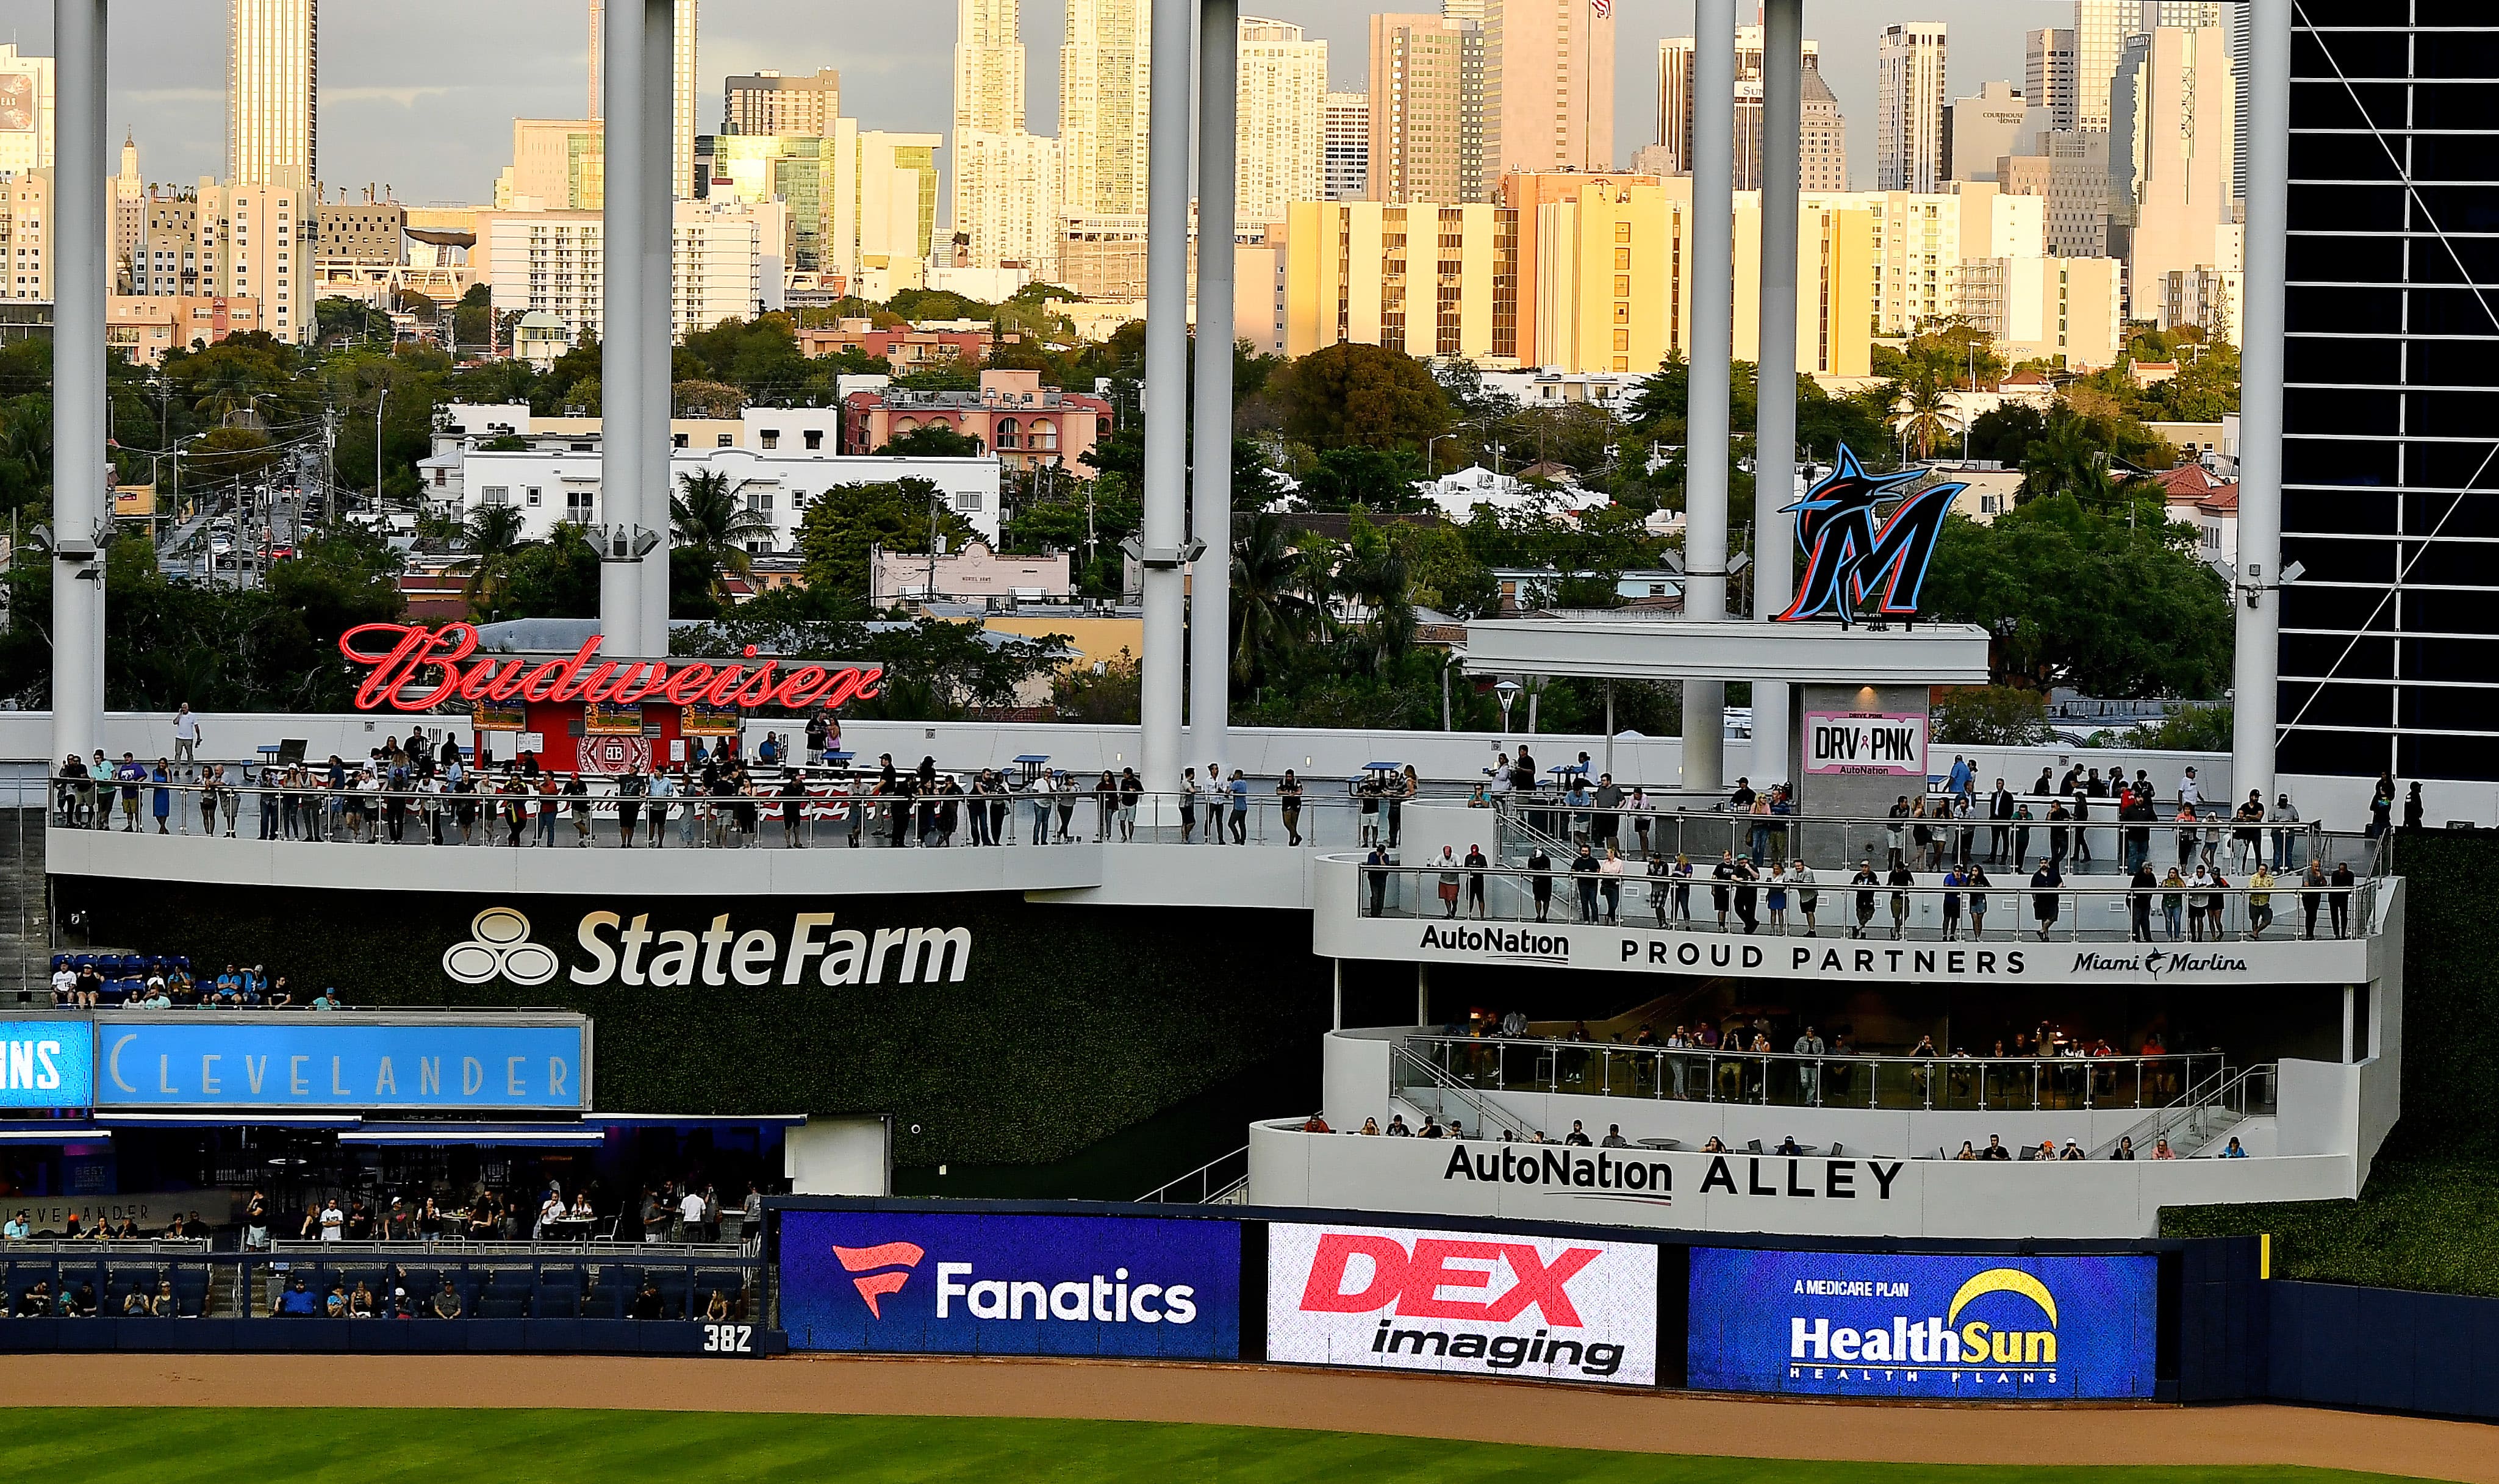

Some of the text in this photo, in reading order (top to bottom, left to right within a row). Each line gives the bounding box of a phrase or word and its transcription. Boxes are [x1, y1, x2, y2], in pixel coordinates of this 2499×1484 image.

[338, 621, 883, 711] Budweiser
[1815, 726, 1915, 761] DRV PNK
[1839, 765, 1889, 775] AutoNation
[1420, 925, 2248, 975] AutoNation PROUD PARTNERS Miami Marlins
[110, 1033, 567, 1095] CLEVELANDER
[1443, 1144, 1904, 1200] AutoNation ALLEY
[936, 1262, 1196, 1324] Fanatics
[1299, 1233, 1604, 1328] DEX
[1794, 1280, 1909, 1297] A MEDICARE PLAN
[704, 1324, 751, 1352] 382
[1371, 1318, 1625, 1376] imaging
[1790, 1316, 2057, 1364] HealthSun
[1790, 1368, 2057, 1384] HEALTH PLANS
